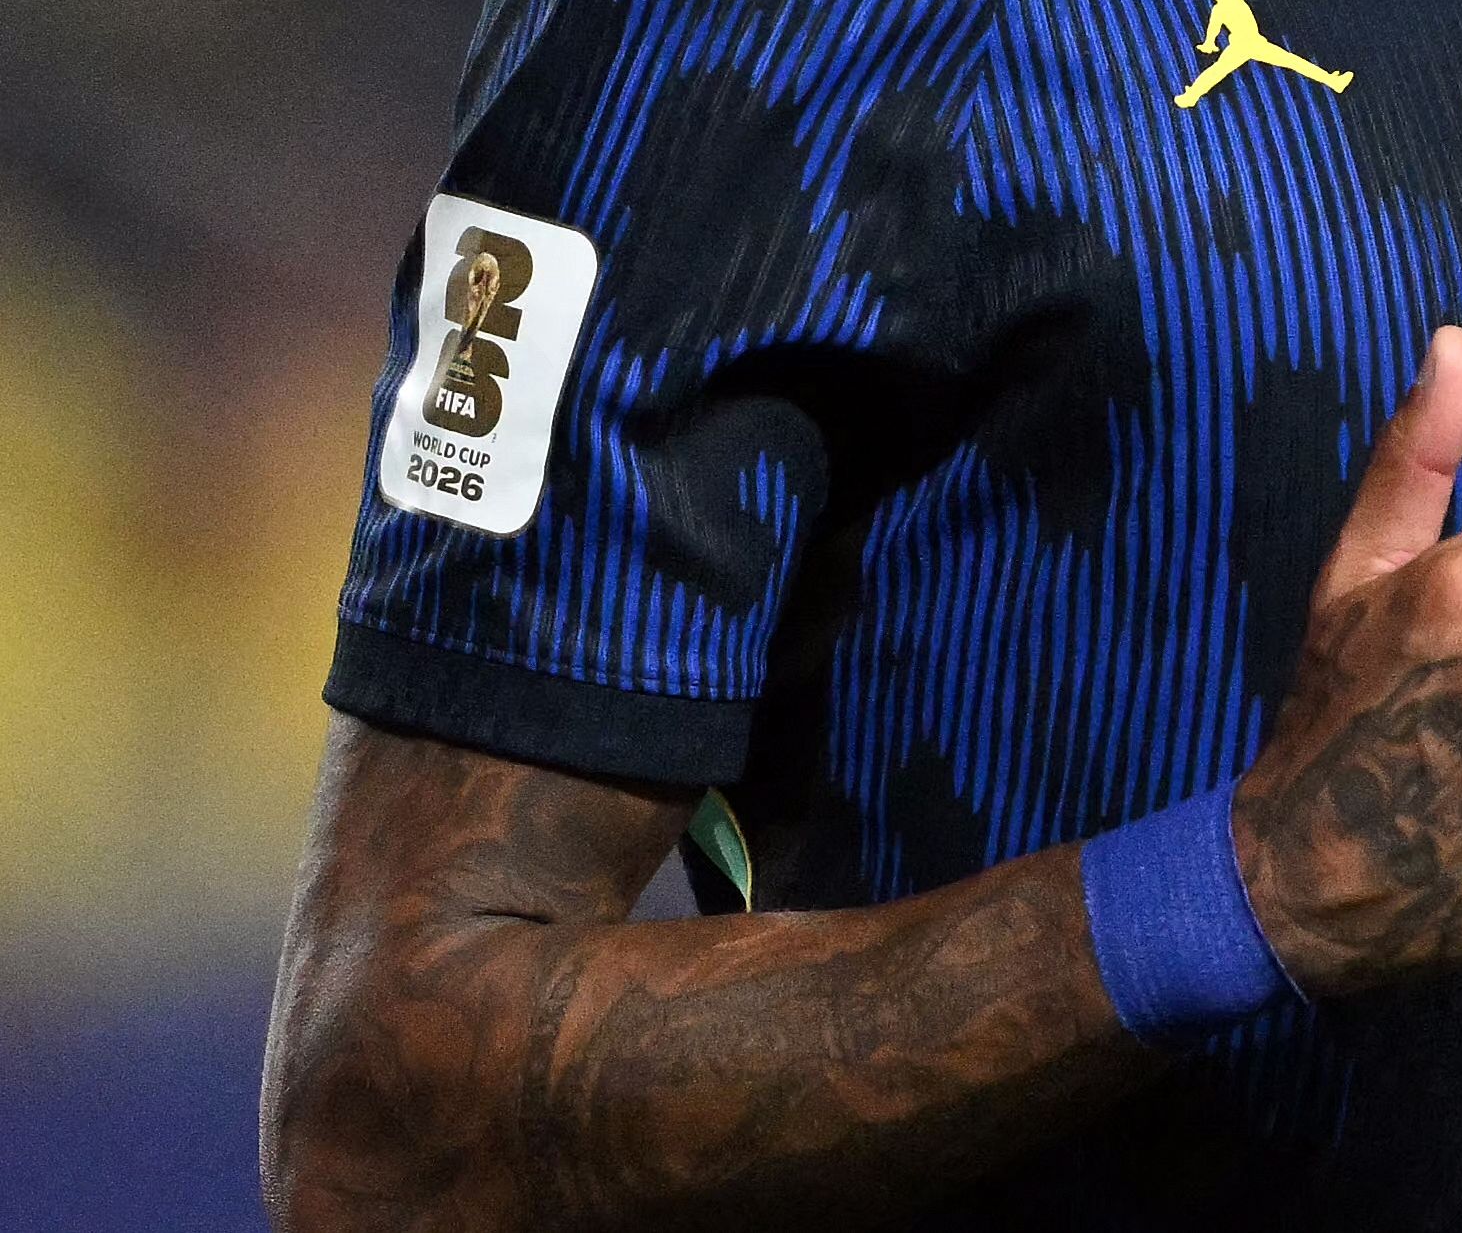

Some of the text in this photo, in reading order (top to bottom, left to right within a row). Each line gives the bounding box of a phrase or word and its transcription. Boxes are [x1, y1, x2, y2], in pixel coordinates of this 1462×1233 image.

[435, 387, 476, 419] FIFA
[413, 430, 491, 468] WORLD CUP
[406, 453, 485, 502] 2026
